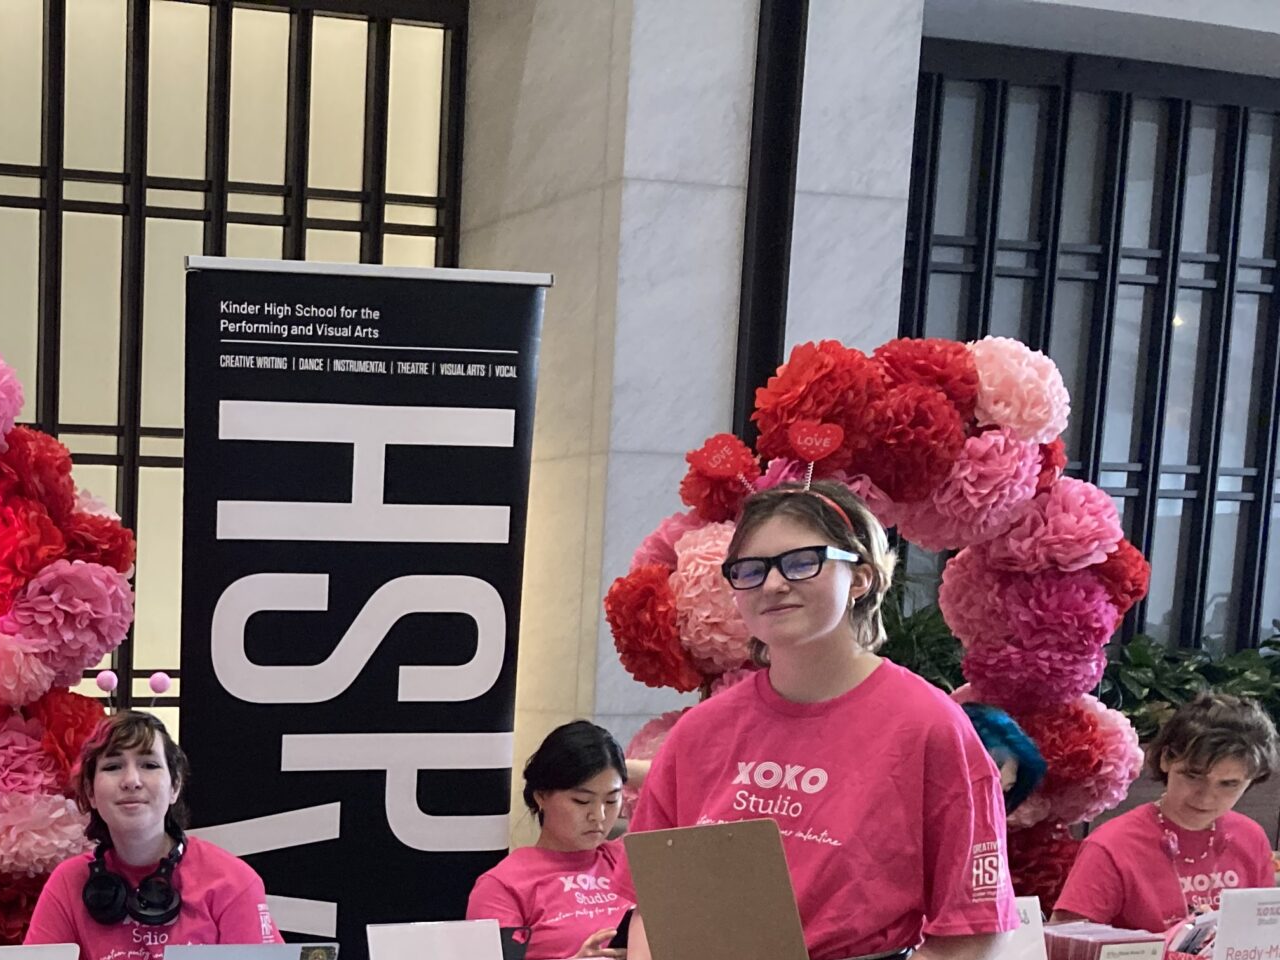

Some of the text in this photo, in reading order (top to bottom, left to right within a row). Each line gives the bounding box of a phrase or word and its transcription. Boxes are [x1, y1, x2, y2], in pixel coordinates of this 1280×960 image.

[220, 300, 380, 320] Kinder High School for the
[220, 319, 380, 338] Performing and Visual Arts
[220, 355, 517, 378] CREATIVE WRITING DANCE INSTRUMENTAL THEATRE VISUAL ARTS VOCAL
[797, 435, 831, 448] LOVE
[707, 445, 733, 469] LOVE
